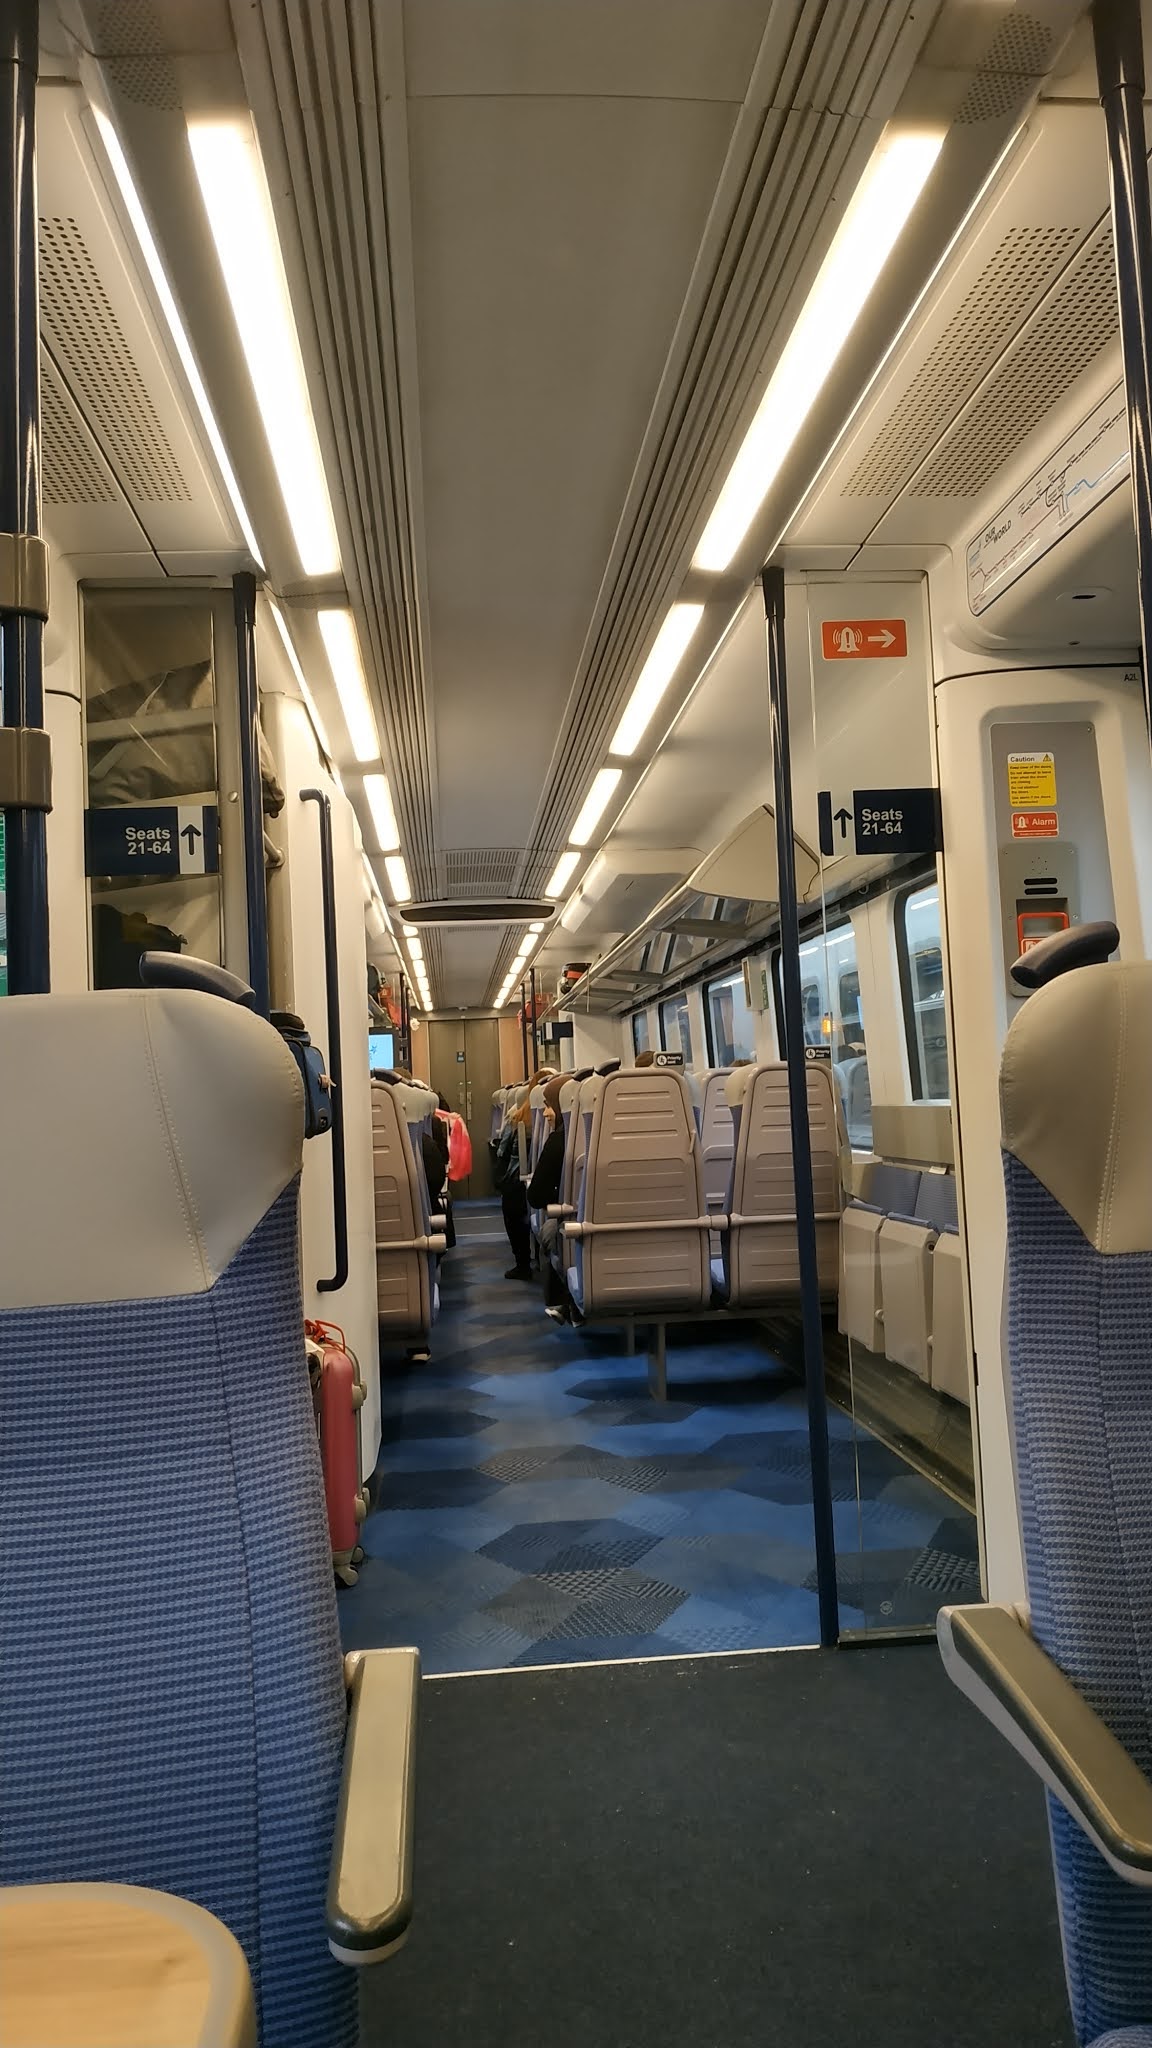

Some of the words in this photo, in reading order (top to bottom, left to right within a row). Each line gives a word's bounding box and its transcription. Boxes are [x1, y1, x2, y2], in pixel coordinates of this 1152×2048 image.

[984, 526, 996, 543] OUR
[993, 519, 1012, 544] WORLD
[861, 808, 904, 821] Seats
[862, 821, 903, 836] 21-64
[1031, 818, 1056, 826] Alarm
[125, 827, 171, 840] Seats
[127, 841, 172, 855] 21-64
